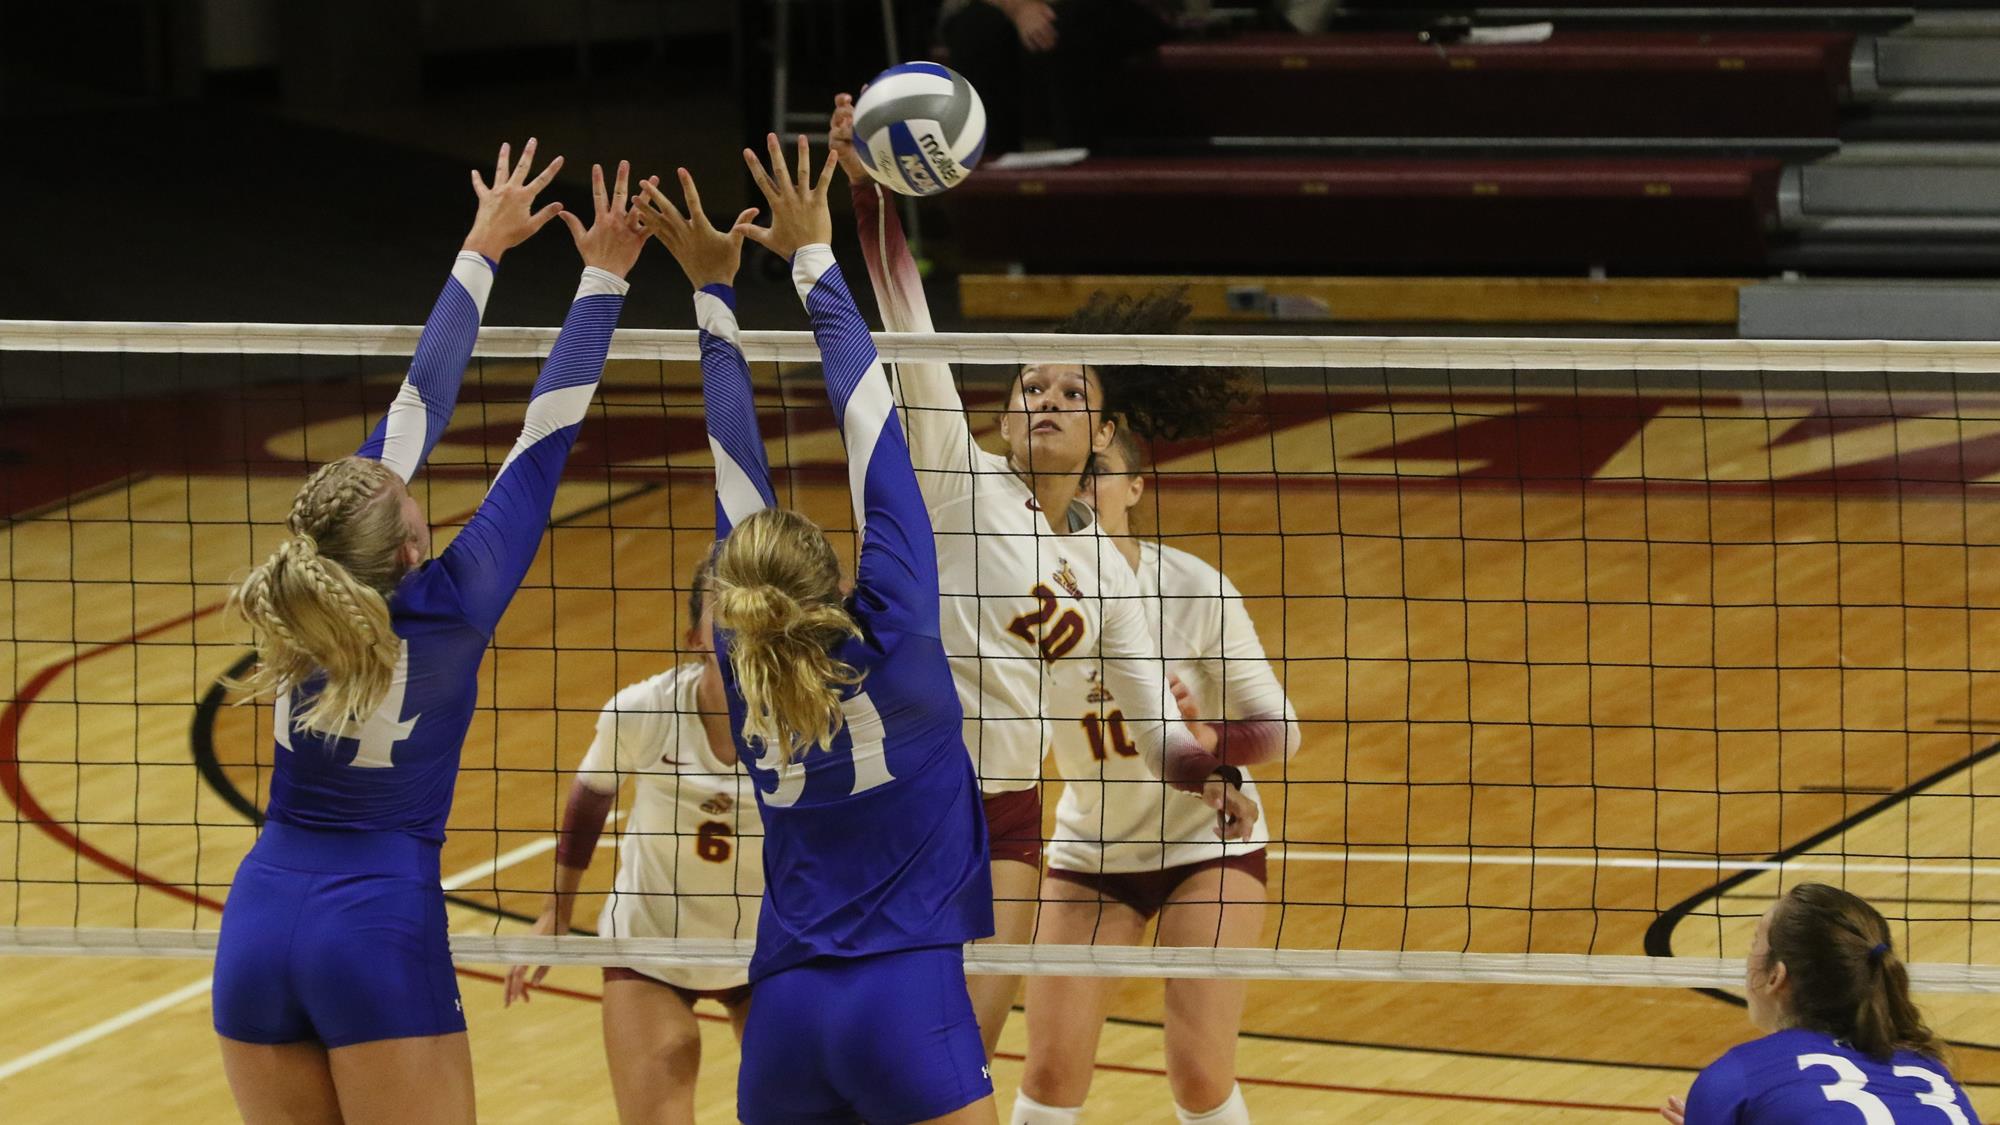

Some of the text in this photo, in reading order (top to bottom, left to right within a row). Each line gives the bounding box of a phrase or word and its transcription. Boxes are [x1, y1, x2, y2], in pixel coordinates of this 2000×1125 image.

[1007, 582, 1086, 664] 20
[696, 819, 733, 864] 6
[1797, 1053, 1972, 1125] 33
